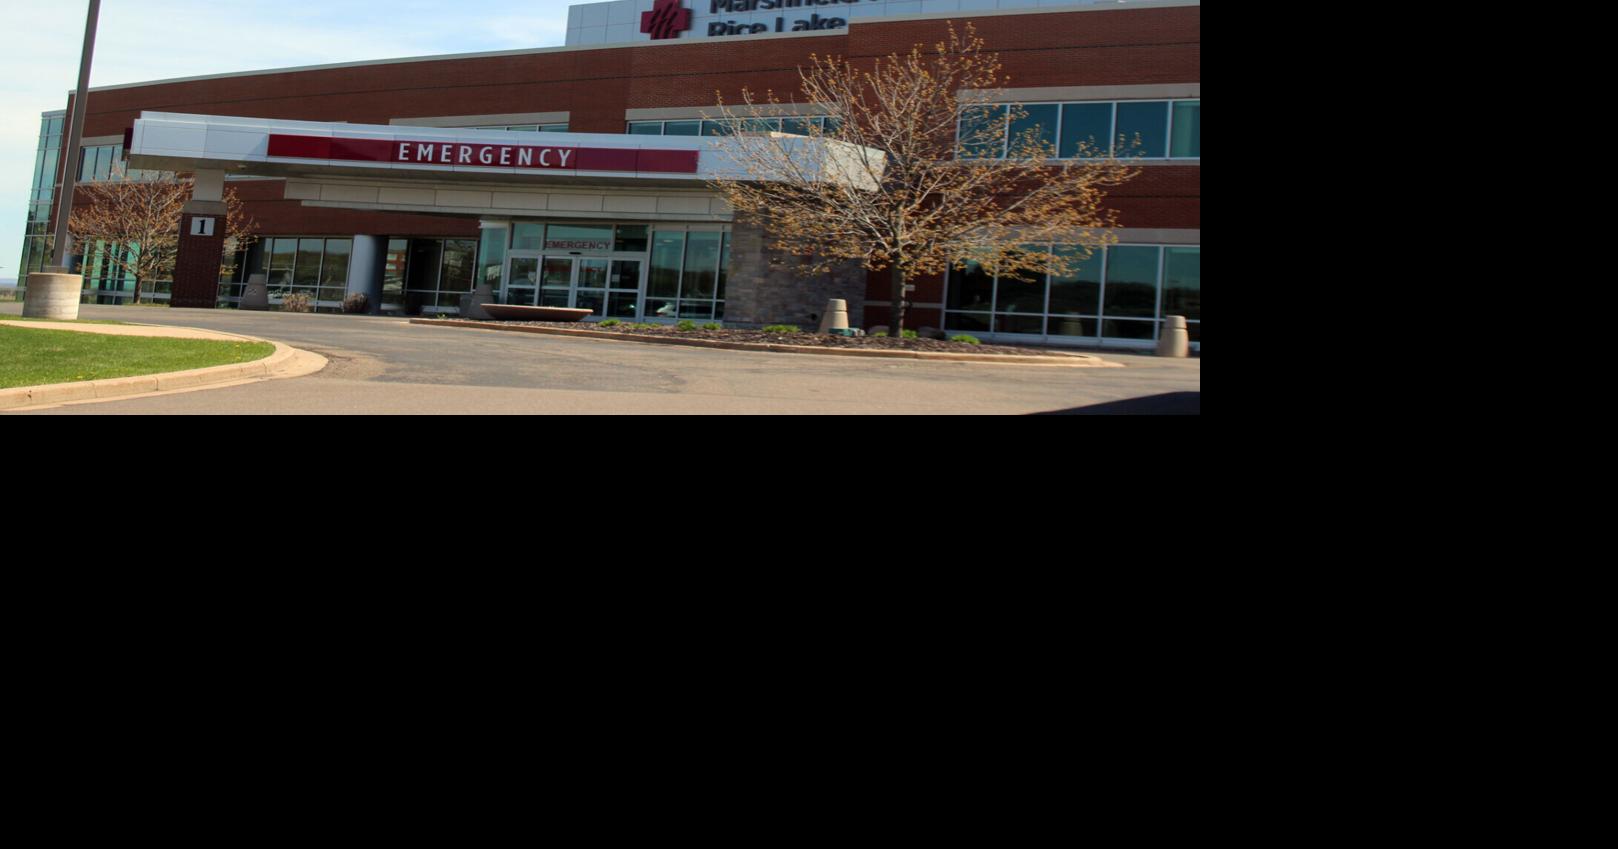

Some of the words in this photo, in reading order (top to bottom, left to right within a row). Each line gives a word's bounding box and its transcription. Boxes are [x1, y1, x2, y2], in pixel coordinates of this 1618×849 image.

[398, 142, 572, 167] EMERGENCY
[198, 219, 206, 234] 1
[545, 241, 610, 249] EMERGENCY
